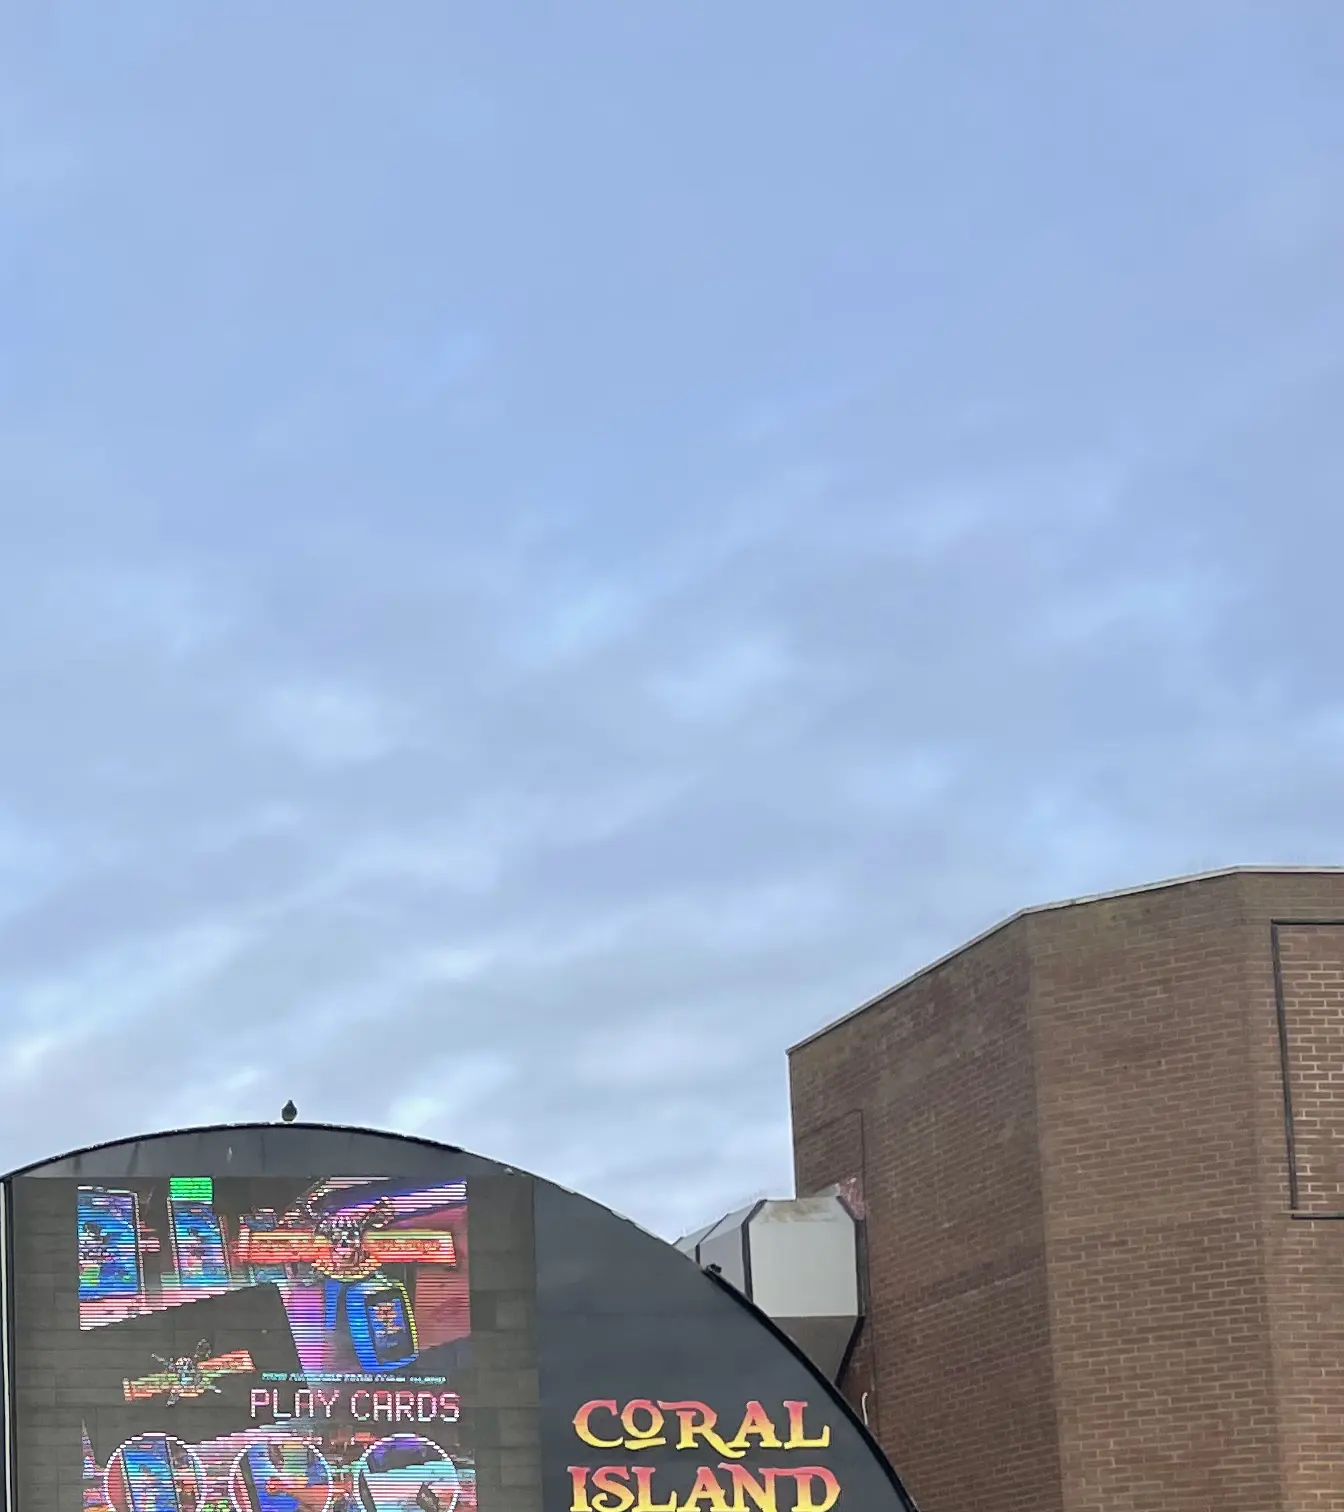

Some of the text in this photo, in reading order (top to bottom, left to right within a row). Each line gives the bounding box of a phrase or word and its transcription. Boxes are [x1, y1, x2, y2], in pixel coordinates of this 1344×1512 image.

[250, 1388, 461, 1422] PLAY CARDS
[572, 1399, 831, 1458] CORAL
